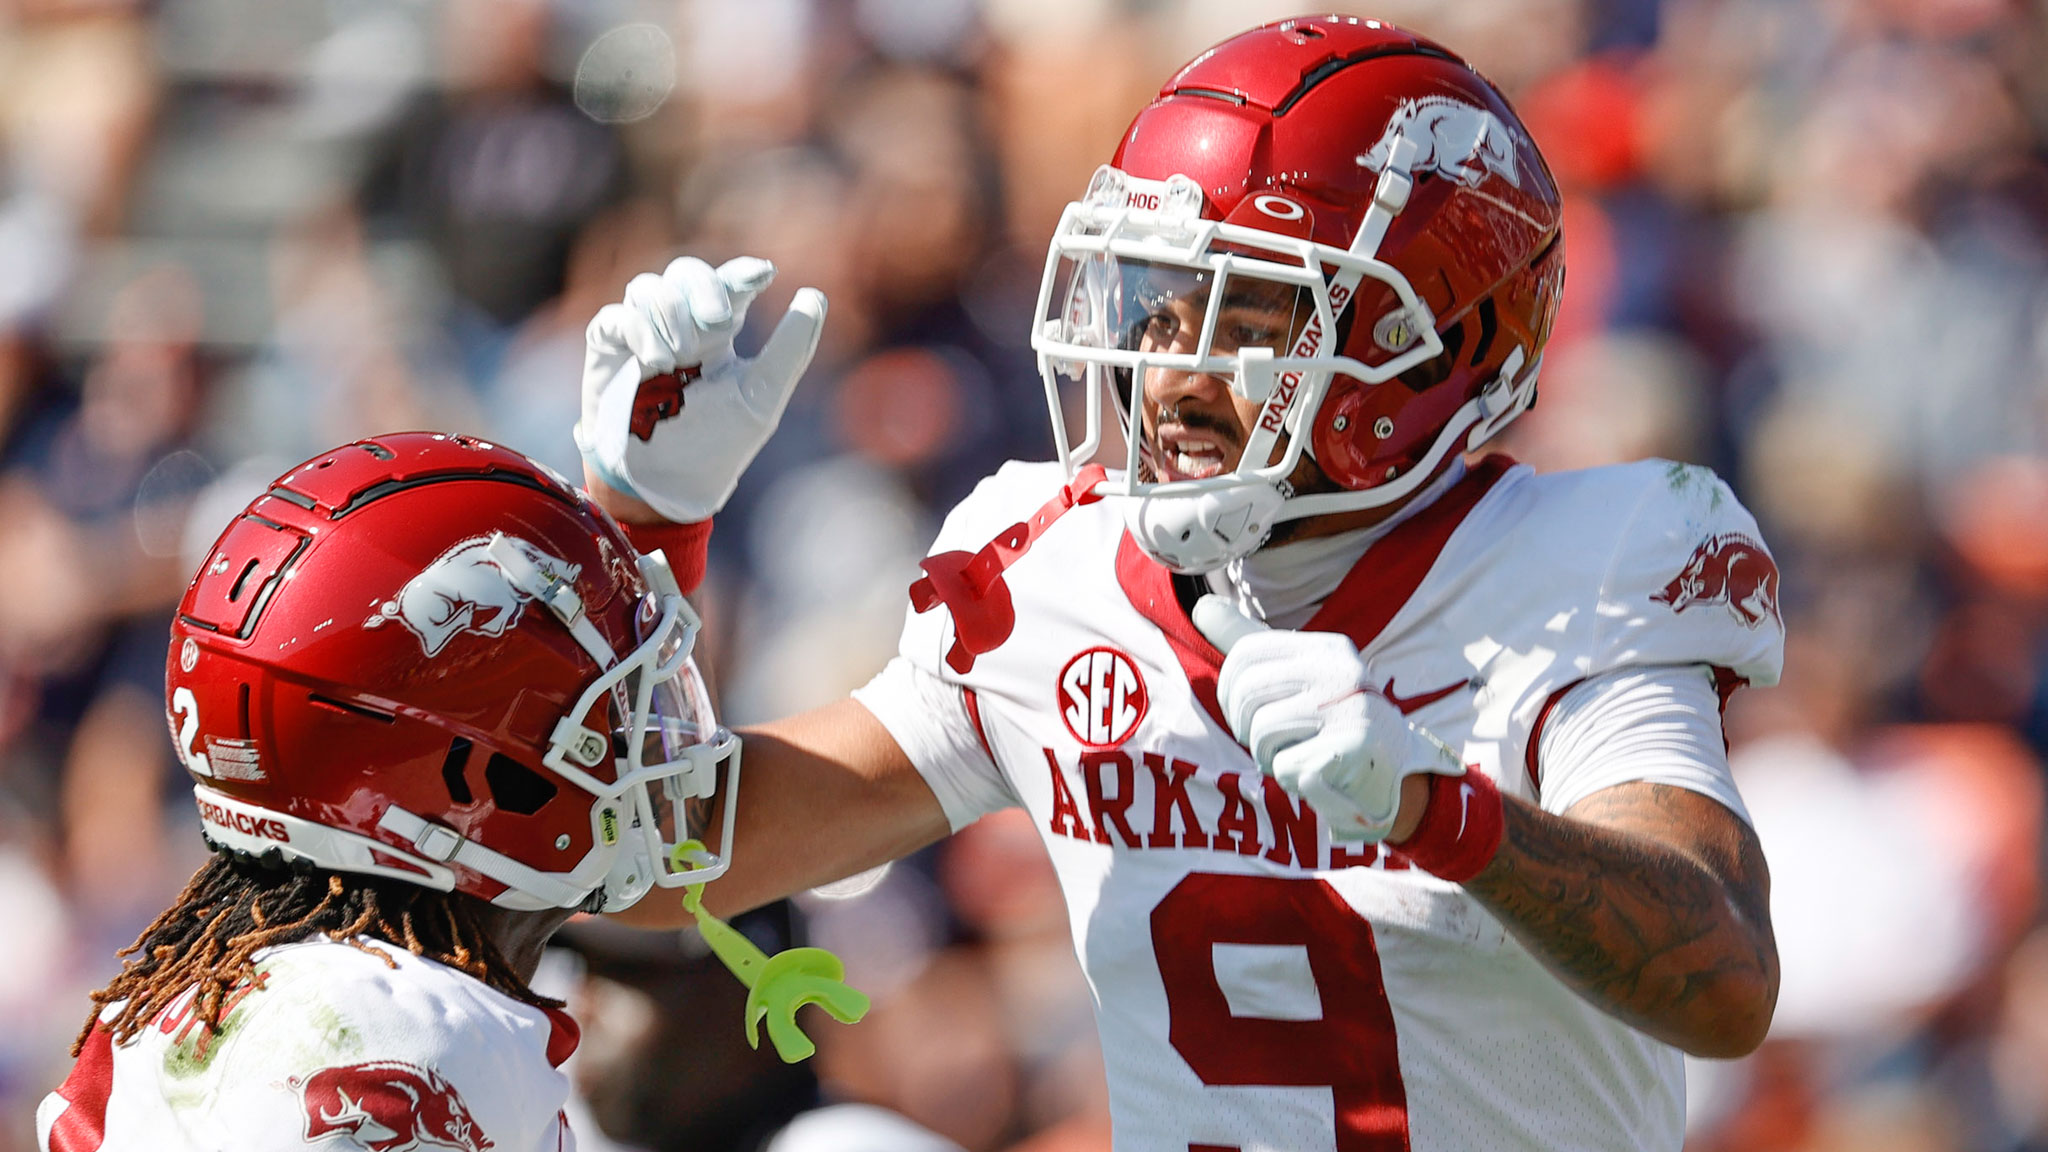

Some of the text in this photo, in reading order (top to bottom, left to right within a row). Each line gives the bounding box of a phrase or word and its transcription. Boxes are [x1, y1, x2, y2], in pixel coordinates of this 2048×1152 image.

[1126, 191, 1161, 211] HOG
[173, 686, 213, 777] 2
[1062, 651, 1139, 745] SEC
[1043, 747, 1411, 872] ARKAN
[1150, 871, 1411, 1152] 9
